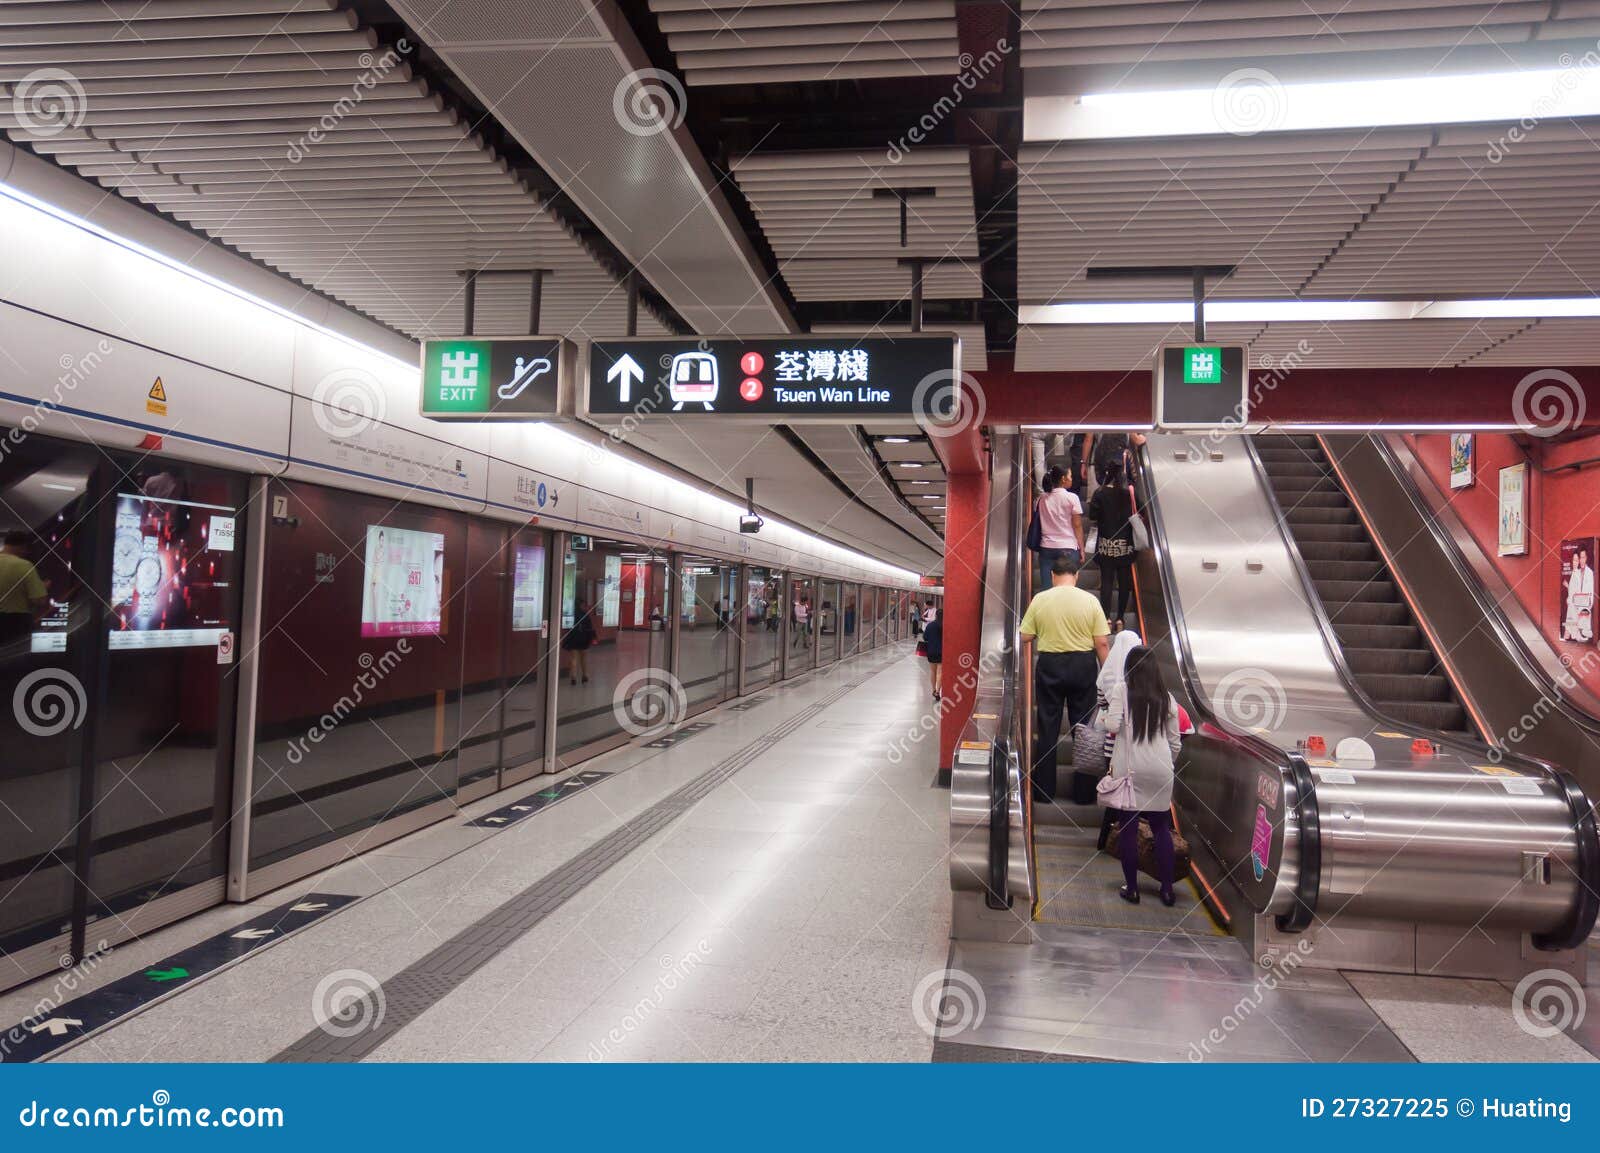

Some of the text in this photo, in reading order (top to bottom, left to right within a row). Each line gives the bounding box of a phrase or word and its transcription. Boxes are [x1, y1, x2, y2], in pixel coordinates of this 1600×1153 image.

[748, 355, 756, 371] 1
[1191, 371, 1213, 379] EXIT
[440, 387, 477, 400] EXIT
[746, 381, 757, 397] 2
[773, 387, 890, 402] Tsuen Wan Line
[277, 499, 284, 515] 7
